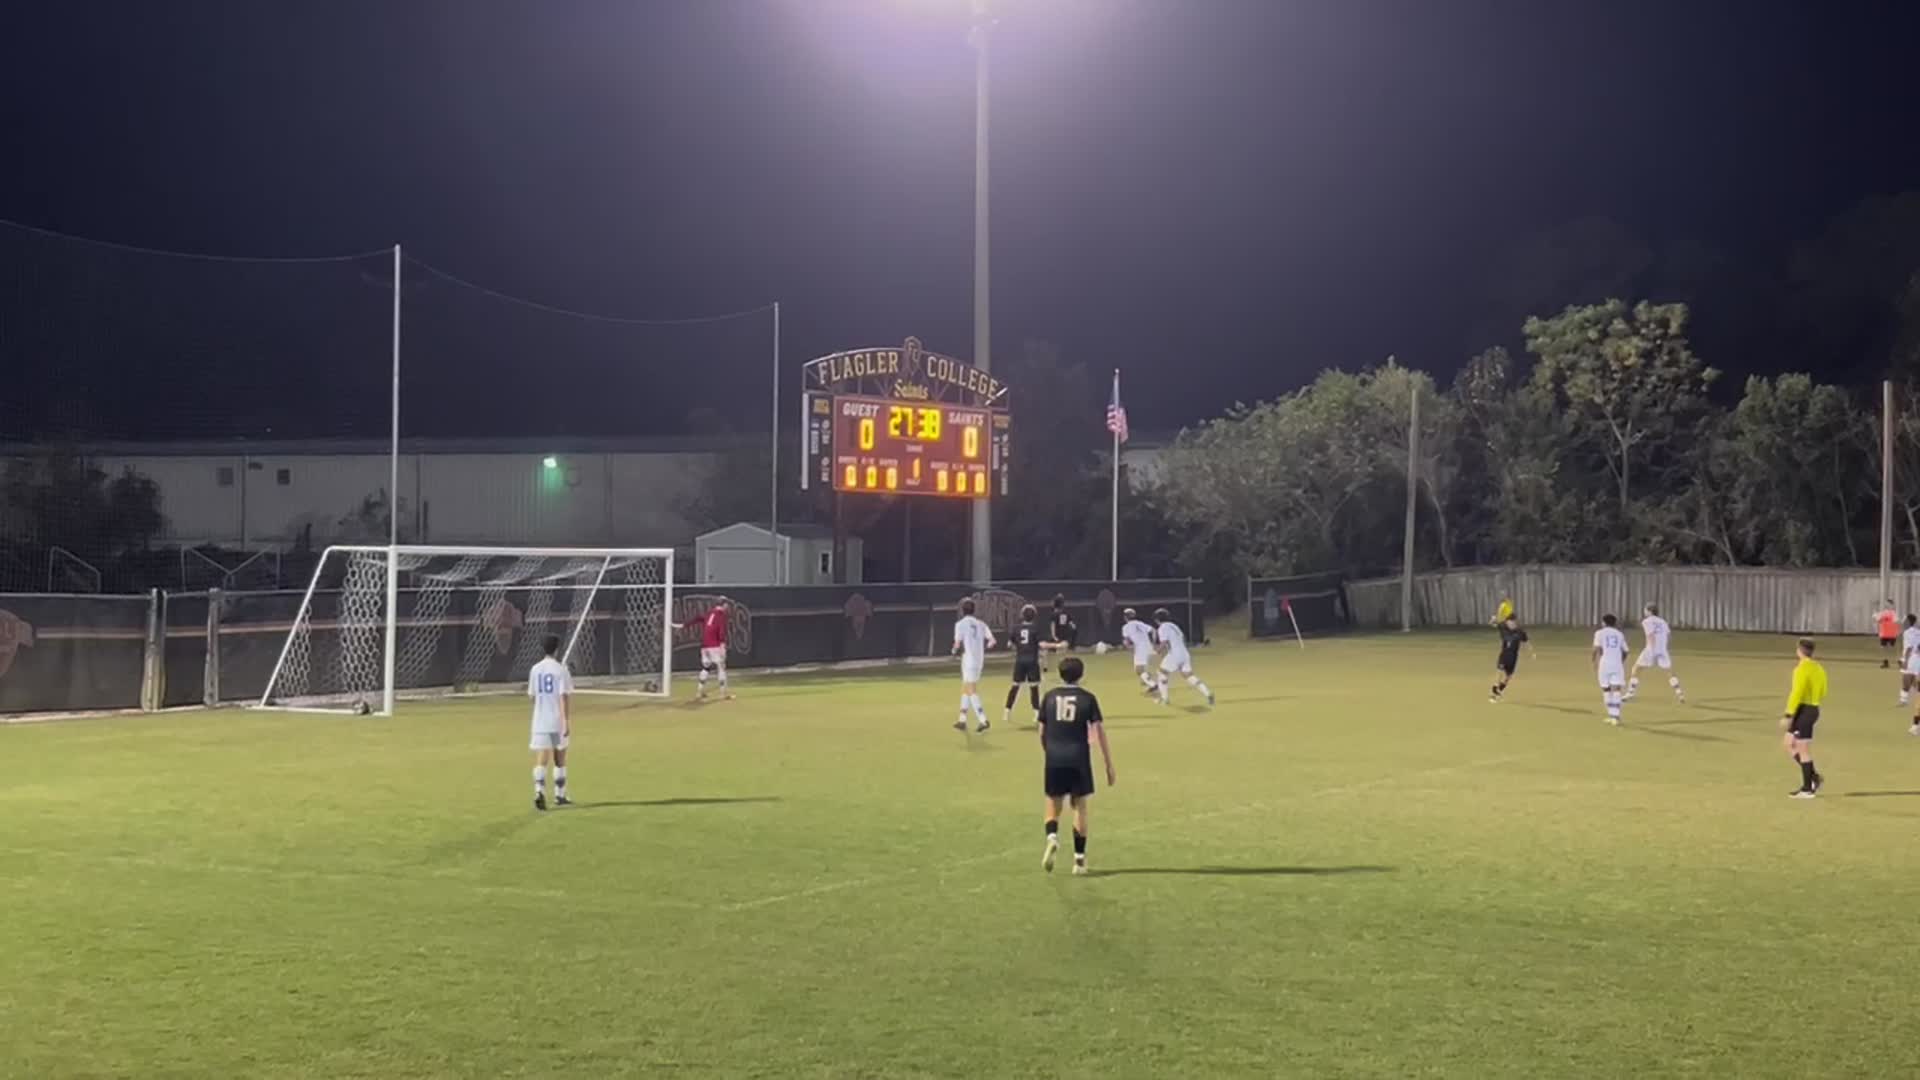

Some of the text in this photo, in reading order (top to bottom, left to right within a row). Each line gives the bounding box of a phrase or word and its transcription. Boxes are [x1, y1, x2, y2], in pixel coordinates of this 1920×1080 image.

[817, 350, 999, 400] FLAGLER COLLEGE
[894, 378, 929, 399] Saints
[843, 402, 880, 417] GUEST
[948, 411, 984, 426] SAINTS
[860, 417, 875, 451] 0
[963, 425, 979, 459] 0
[845, 464, 857, 488] 0
[866, 465, 878, 489] 0
[912, 457, 920, 480] 1
[956, 470, 968, 493] 0
[707, 613, 716, 626] 1
[1020, 629, 1030, 645] 9
[1605, 634, 1618, 649] 13
[537, 672, 554, 694] 18
[1055, 695, 1078, 722] 16
